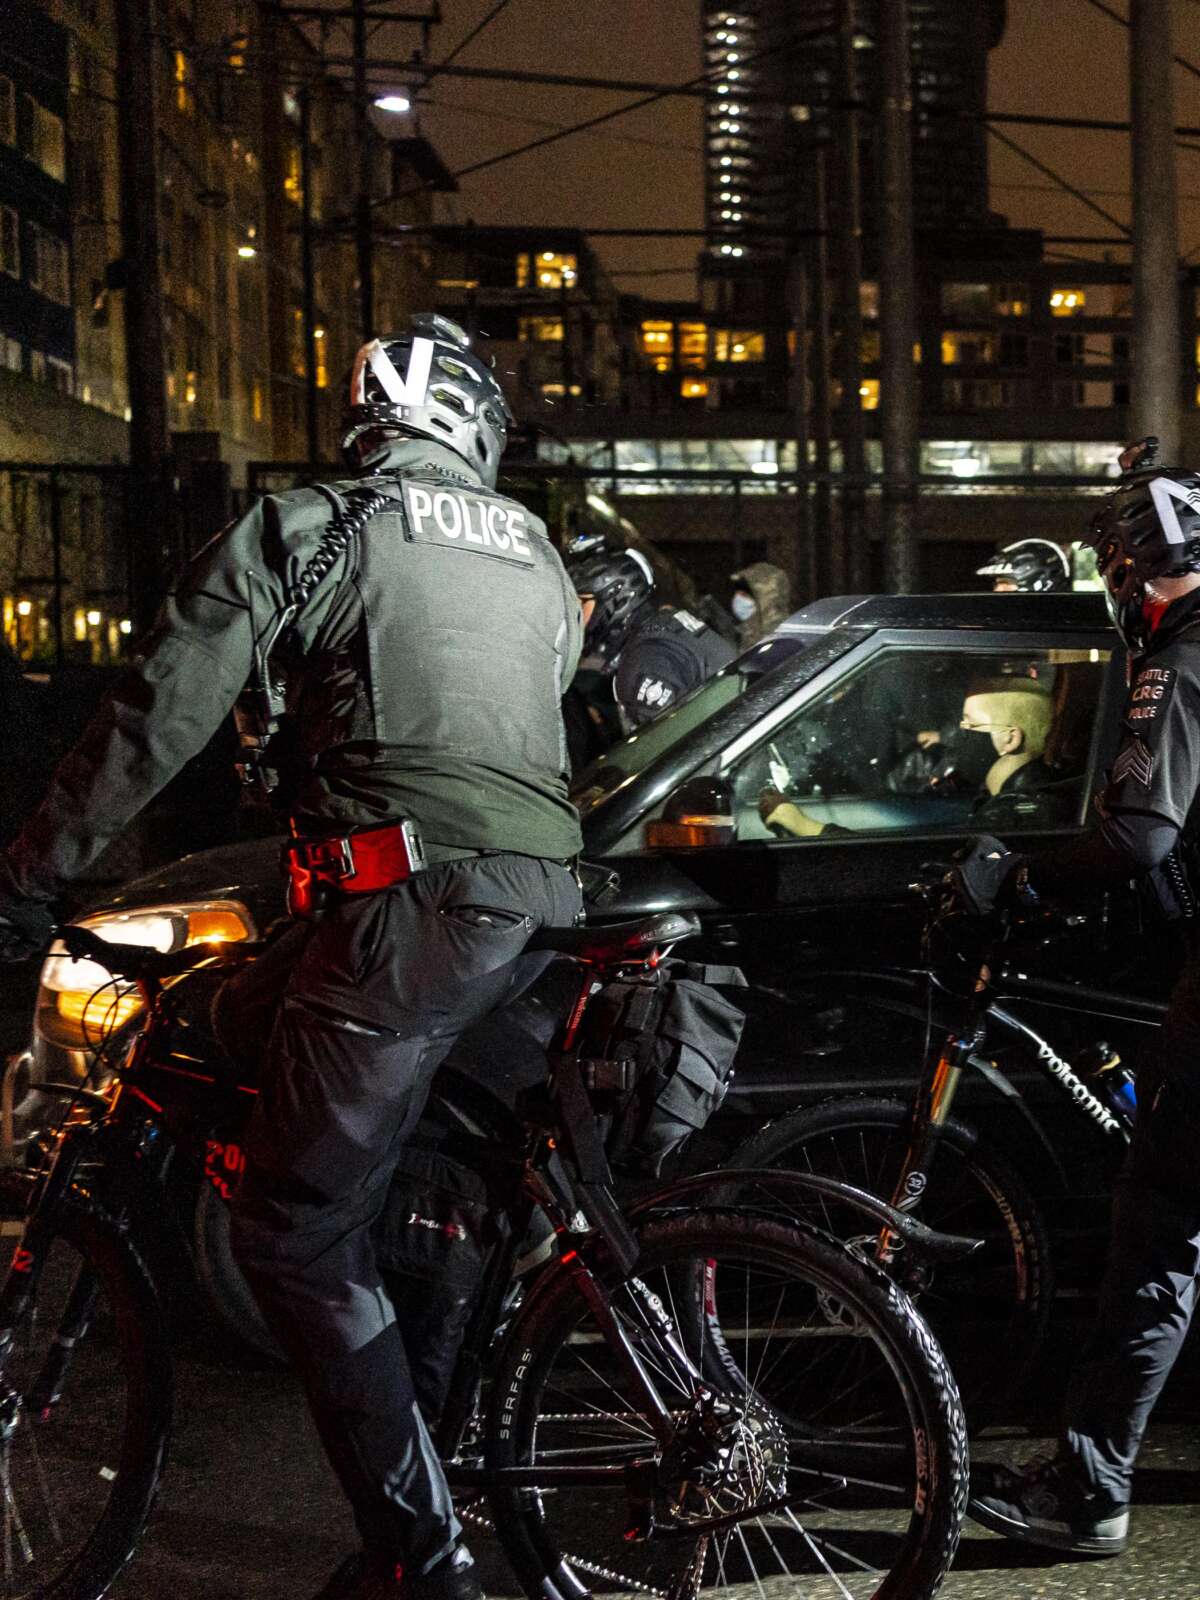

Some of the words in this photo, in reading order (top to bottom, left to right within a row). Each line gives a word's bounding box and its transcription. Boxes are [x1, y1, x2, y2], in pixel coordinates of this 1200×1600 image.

[407, 486, 532, 557] POLICE
[1132, 685, 1165, 703] CRG
[499, 1350, 532, 1440] SERFAS
